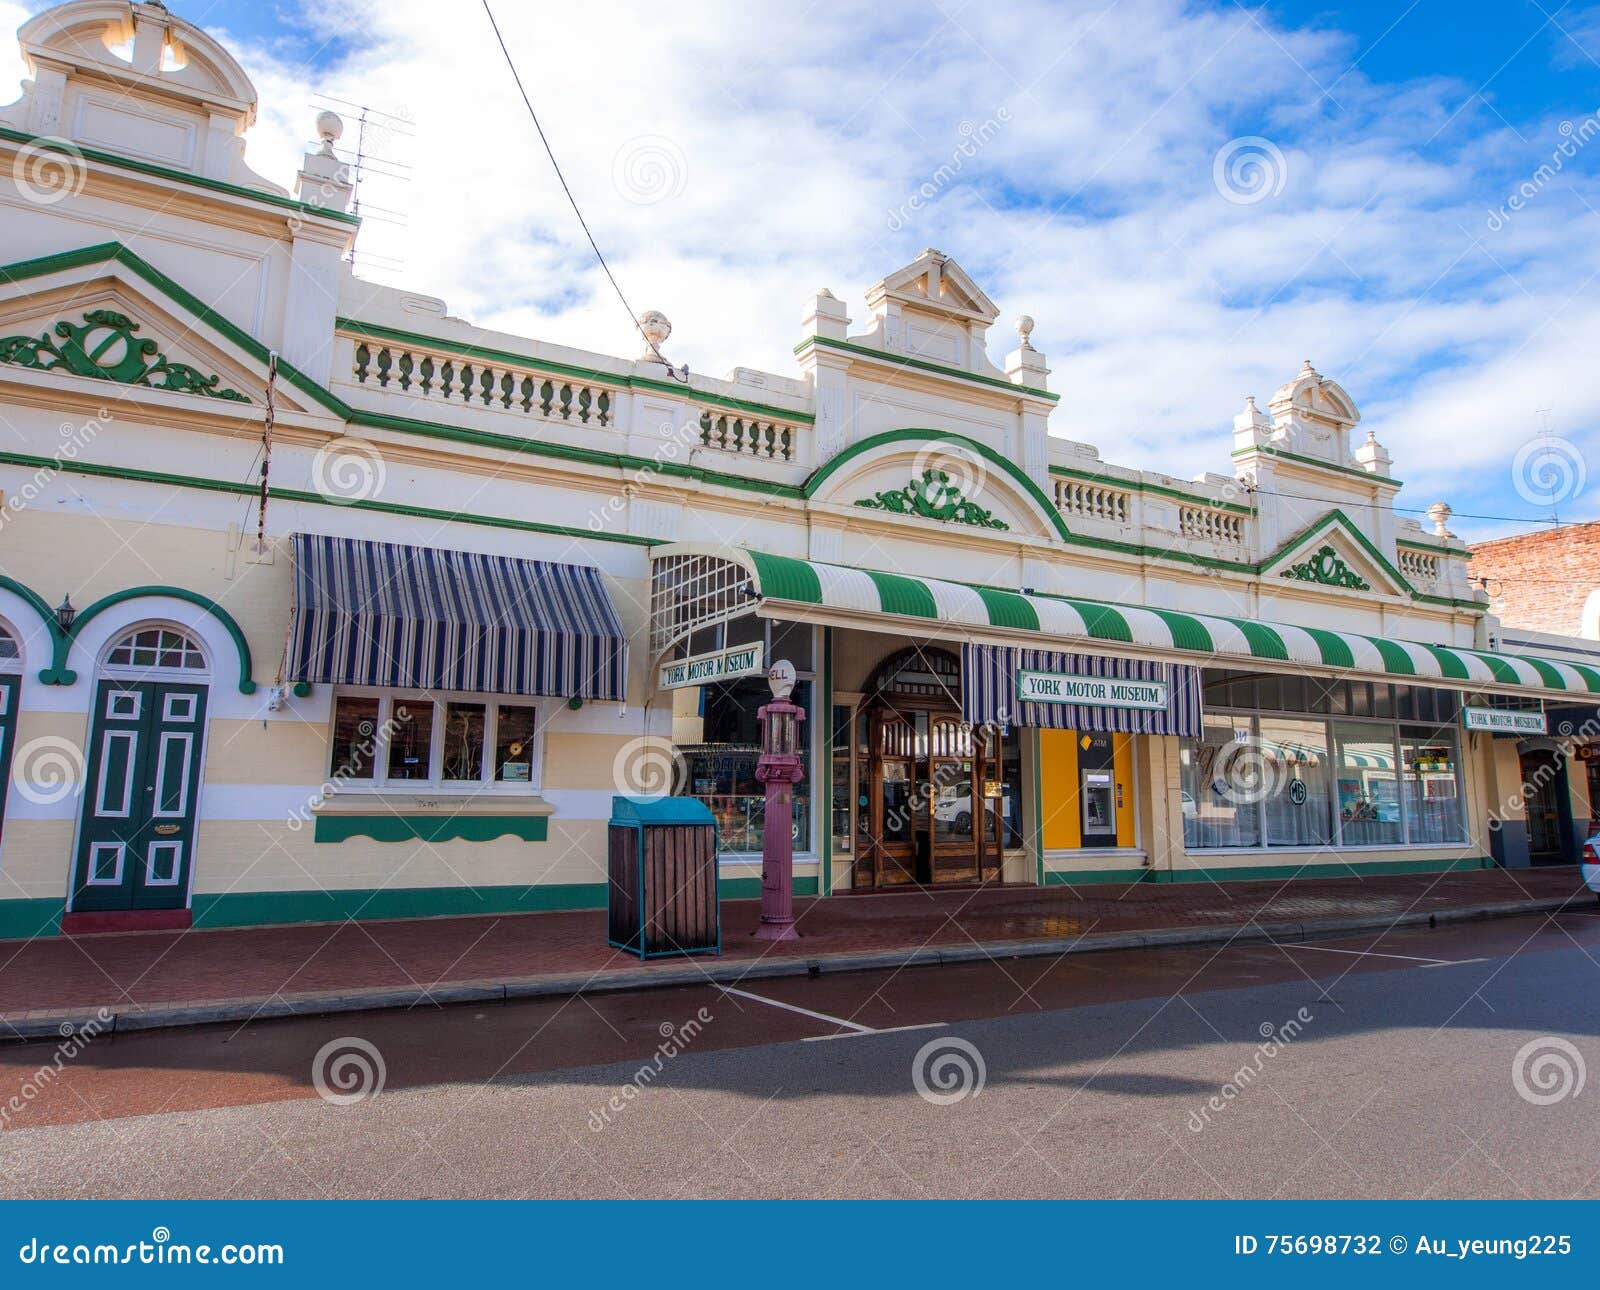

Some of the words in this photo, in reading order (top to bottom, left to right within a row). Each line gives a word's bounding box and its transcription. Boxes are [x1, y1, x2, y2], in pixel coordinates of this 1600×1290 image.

[667, 667, 686, 684] YORK
[687, 661, 713, 681] MOTOR
[716, 650, 755, 675] MUSEUM
[1029, 678, 1061, 695] YORK
[1066, 681, 1106, 698] MOTOR
[1110, 684, 1159, 702] MUSEUM
[1470, 712, 1489, 725] YORK
[1489, 714, 1513, 727] MOTOR
[1514, 716, 1542, 729] MUSEUM
[1291, 780, 1305, 803] MG
